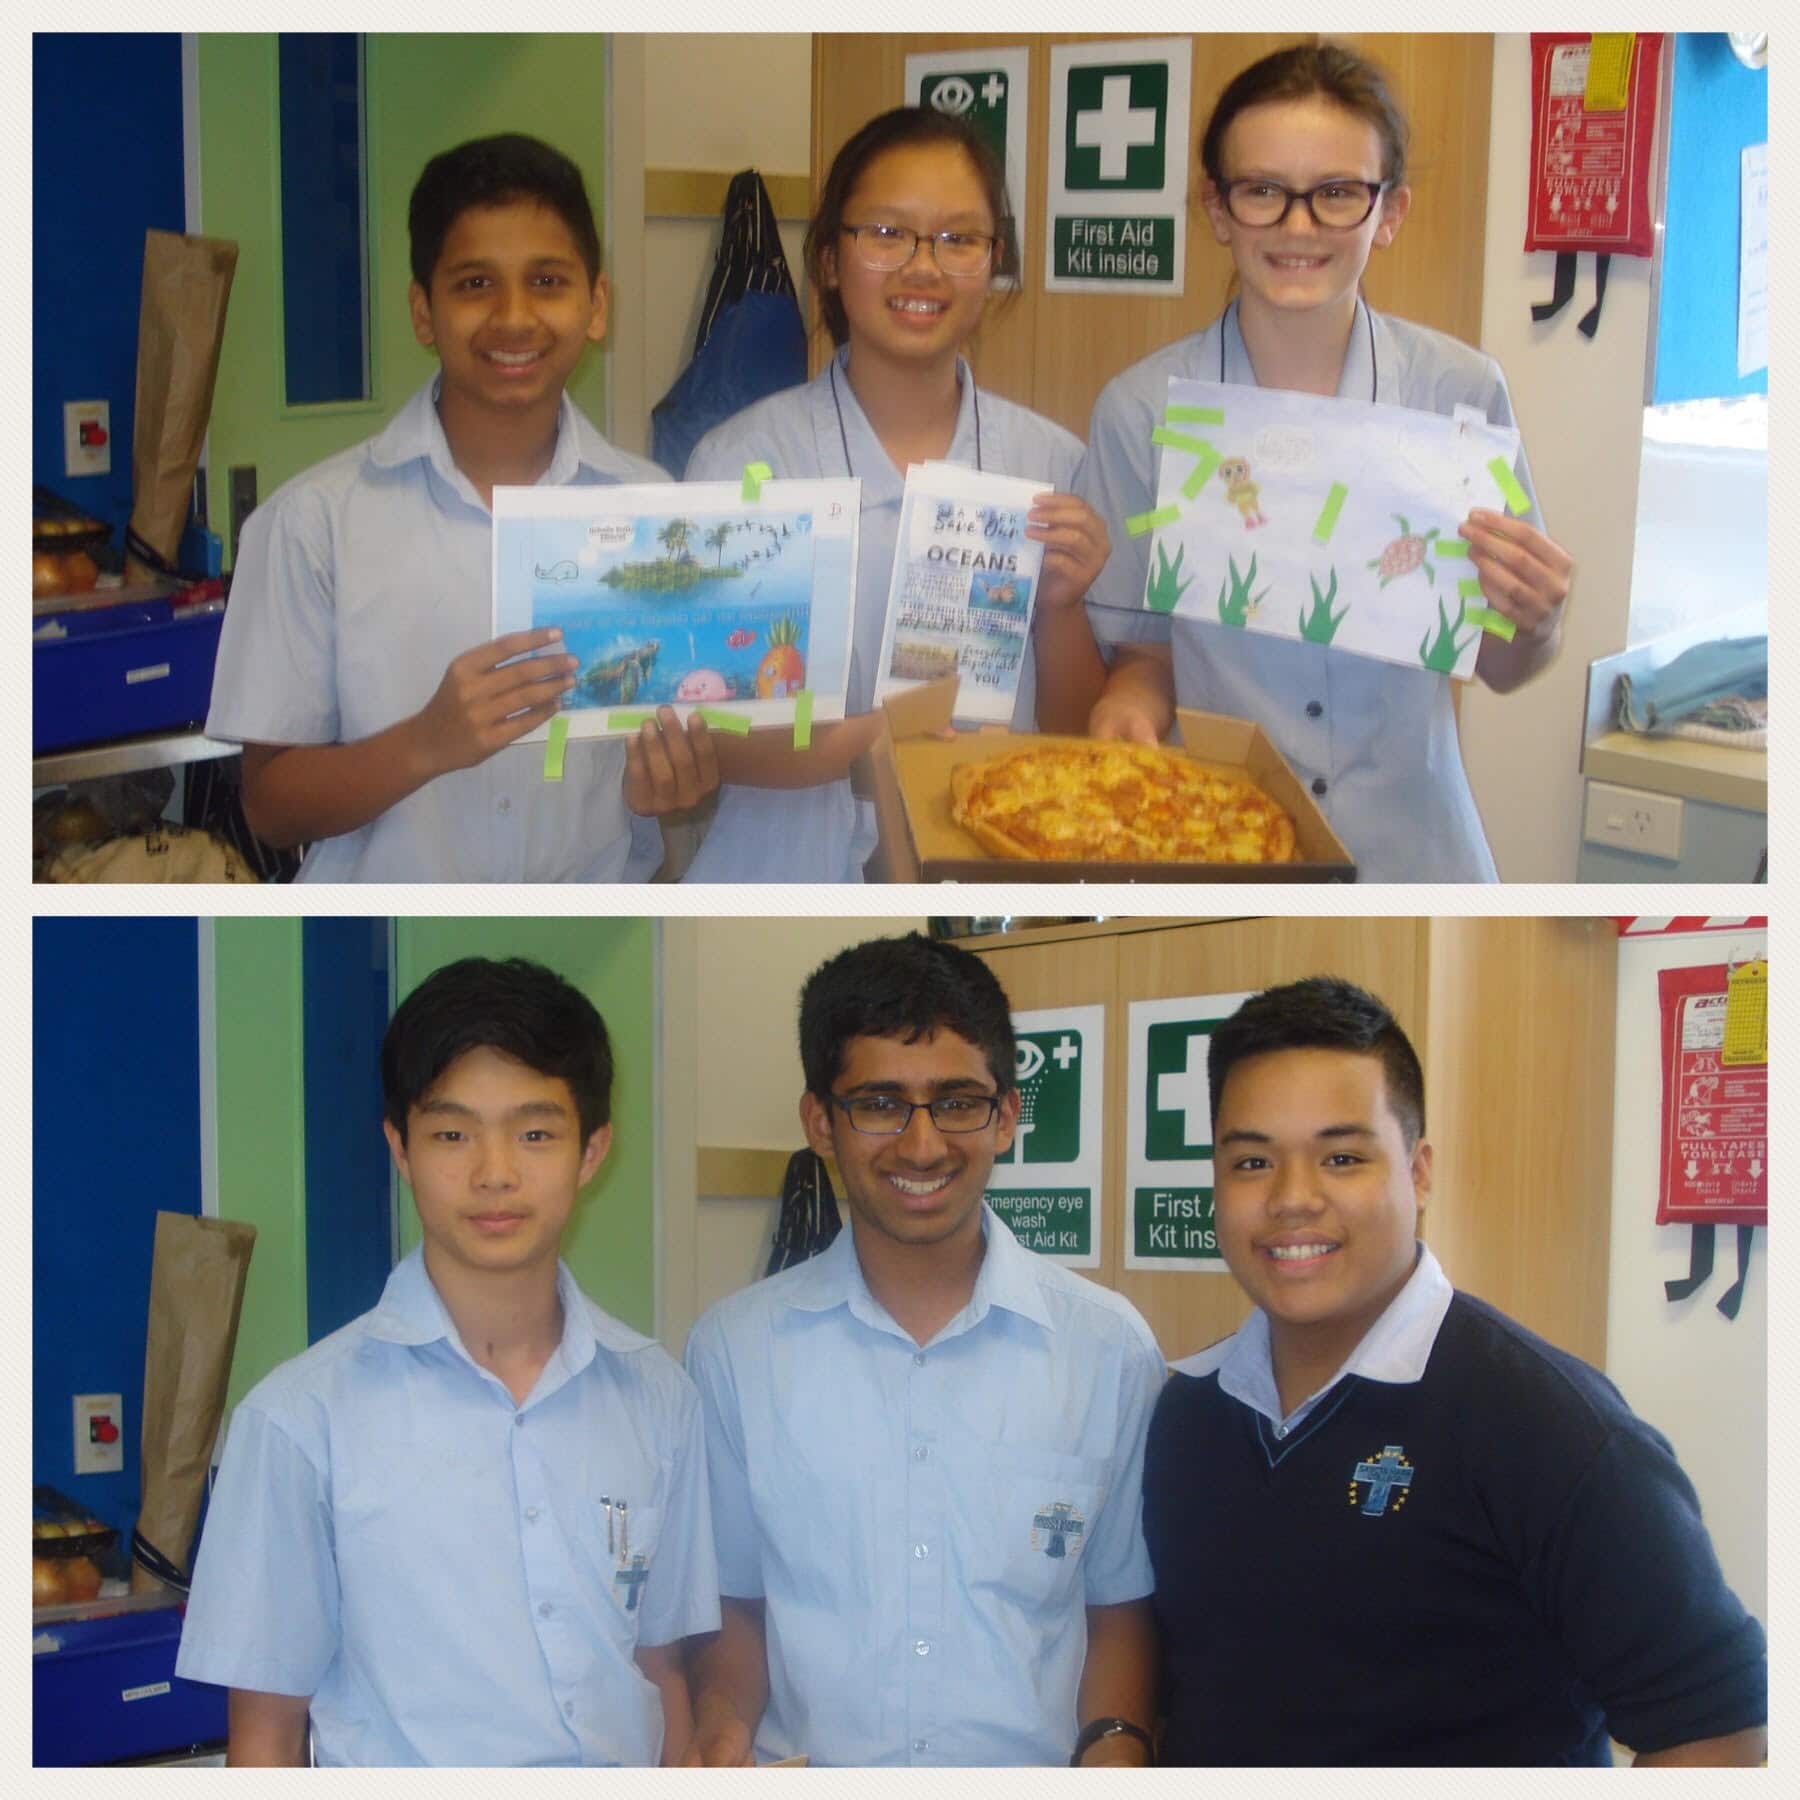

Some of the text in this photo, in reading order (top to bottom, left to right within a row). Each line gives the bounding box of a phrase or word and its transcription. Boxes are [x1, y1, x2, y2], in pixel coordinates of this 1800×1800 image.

[1071, 219, 1154, 247] First Aid
[1067, 248, 1092, 273] Kit
[927, 544, 1018, 572] OCEANS
[1680, 1141, 1765, 1151] PULL TAPES
[1058, 1196, 1084, 1213] eye
[1153, 1193, 1202, 1218] First
[1012, 1212, 1047, 1228] wash
[1033, 1231, 1056, 1248] Aid
[1060, 1231, 1079, 1248] Kit
[1148, 1223, 1217, 1249] Kit ins
